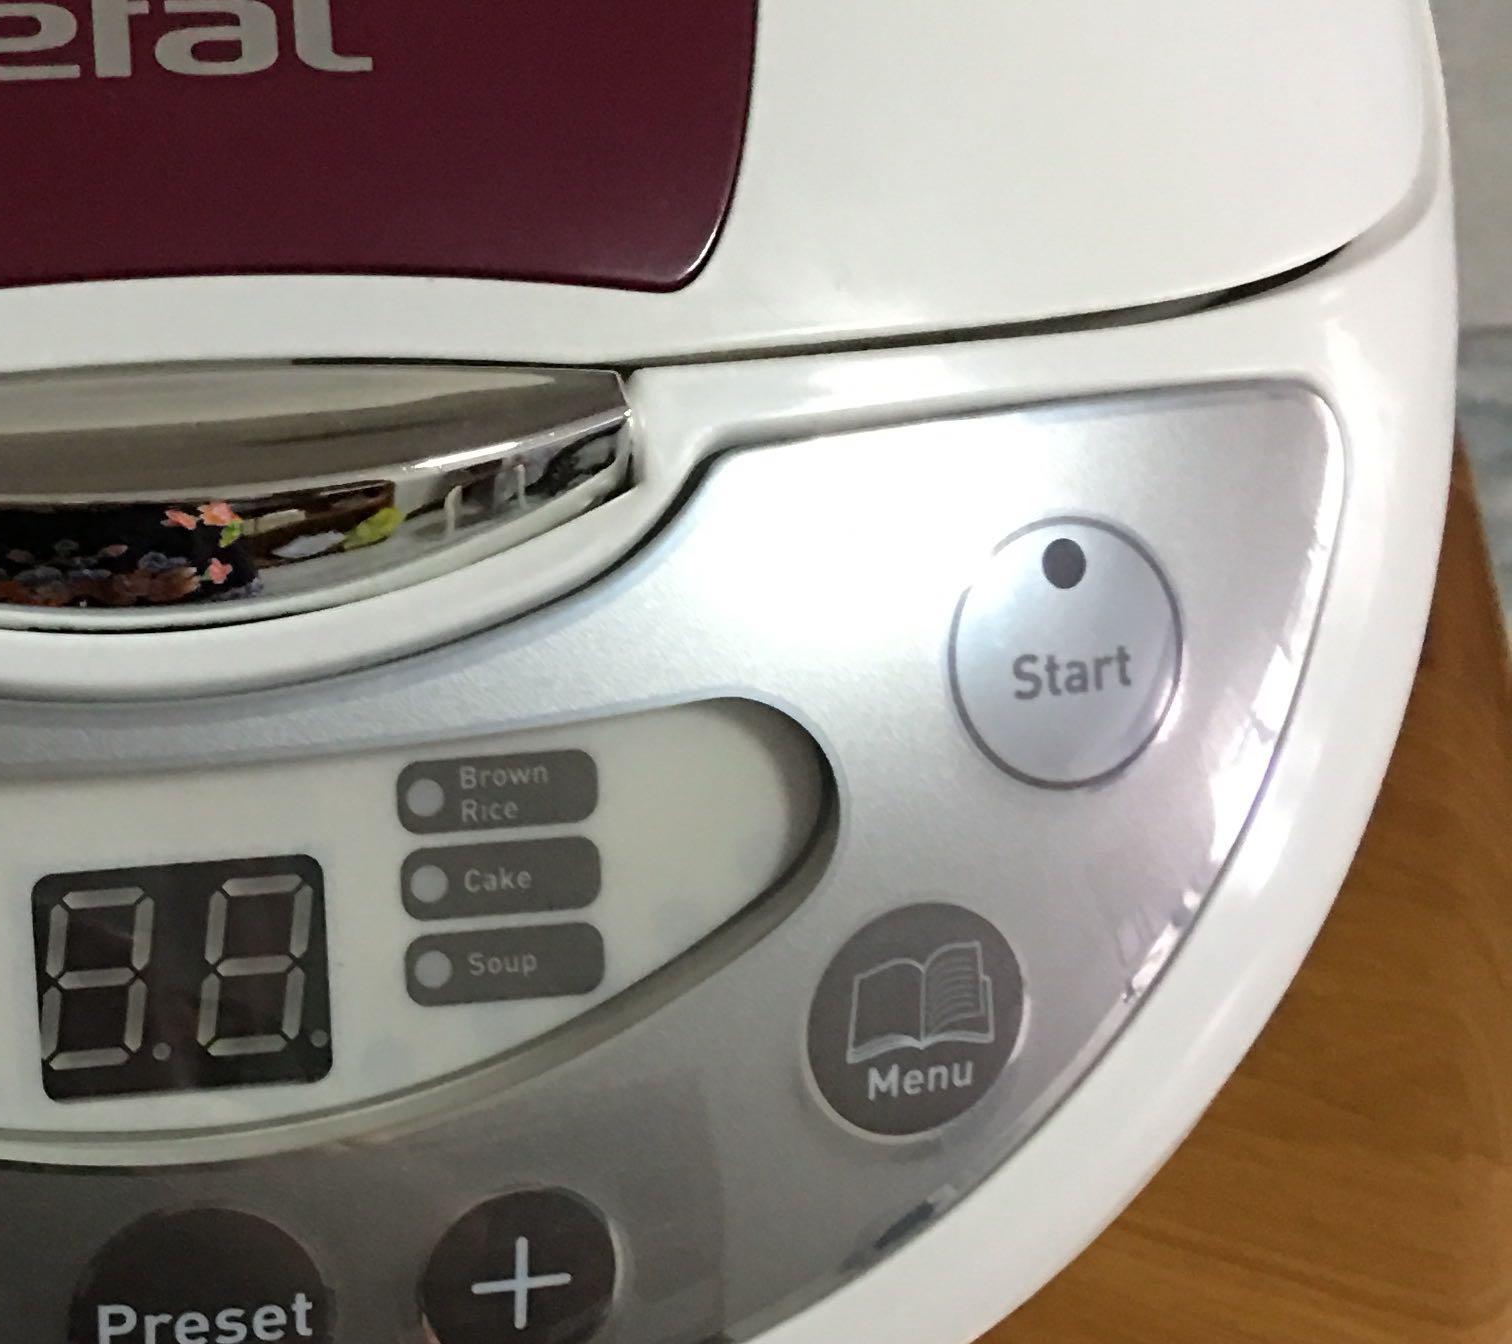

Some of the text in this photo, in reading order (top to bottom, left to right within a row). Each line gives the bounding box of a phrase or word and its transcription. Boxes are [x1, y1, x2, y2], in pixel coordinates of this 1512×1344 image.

[1012, 645, 1133, 701] Start
[459, 764, 549, 790] Brown
[461, 798, 519, 823] Rice
[463, 866, 532, 893] Cake
[466, 952, 538, 978] Soup
[867, 1060, 974, 1101] Menu
